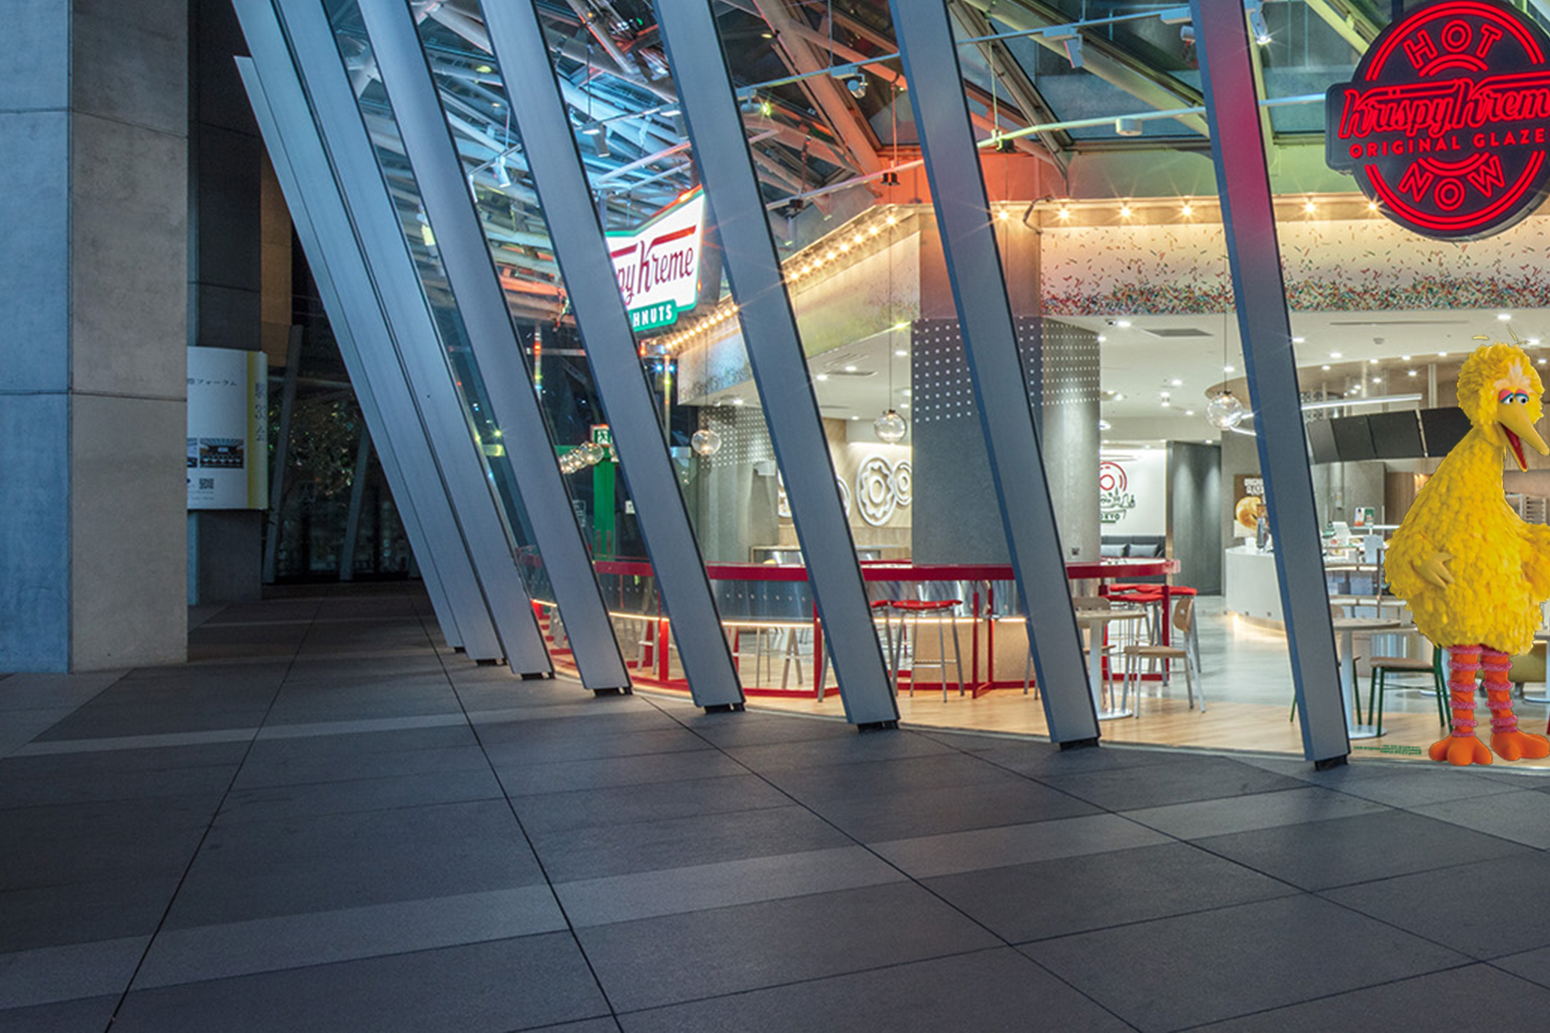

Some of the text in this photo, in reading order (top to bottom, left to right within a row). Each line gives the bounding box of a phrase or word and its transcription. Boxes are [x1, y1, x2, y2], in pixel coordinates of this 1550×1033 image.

[1402, 19, 1502, 69] HOT
[1338, 79, 1456, 139] Krispy
[1349, 136, 1461, 159] ORIGINAL
[1398, 156, 1505, 211] NOW
[637, 232, 696, 295] Kreme
[632, 304, 673, 328] HNUTS
